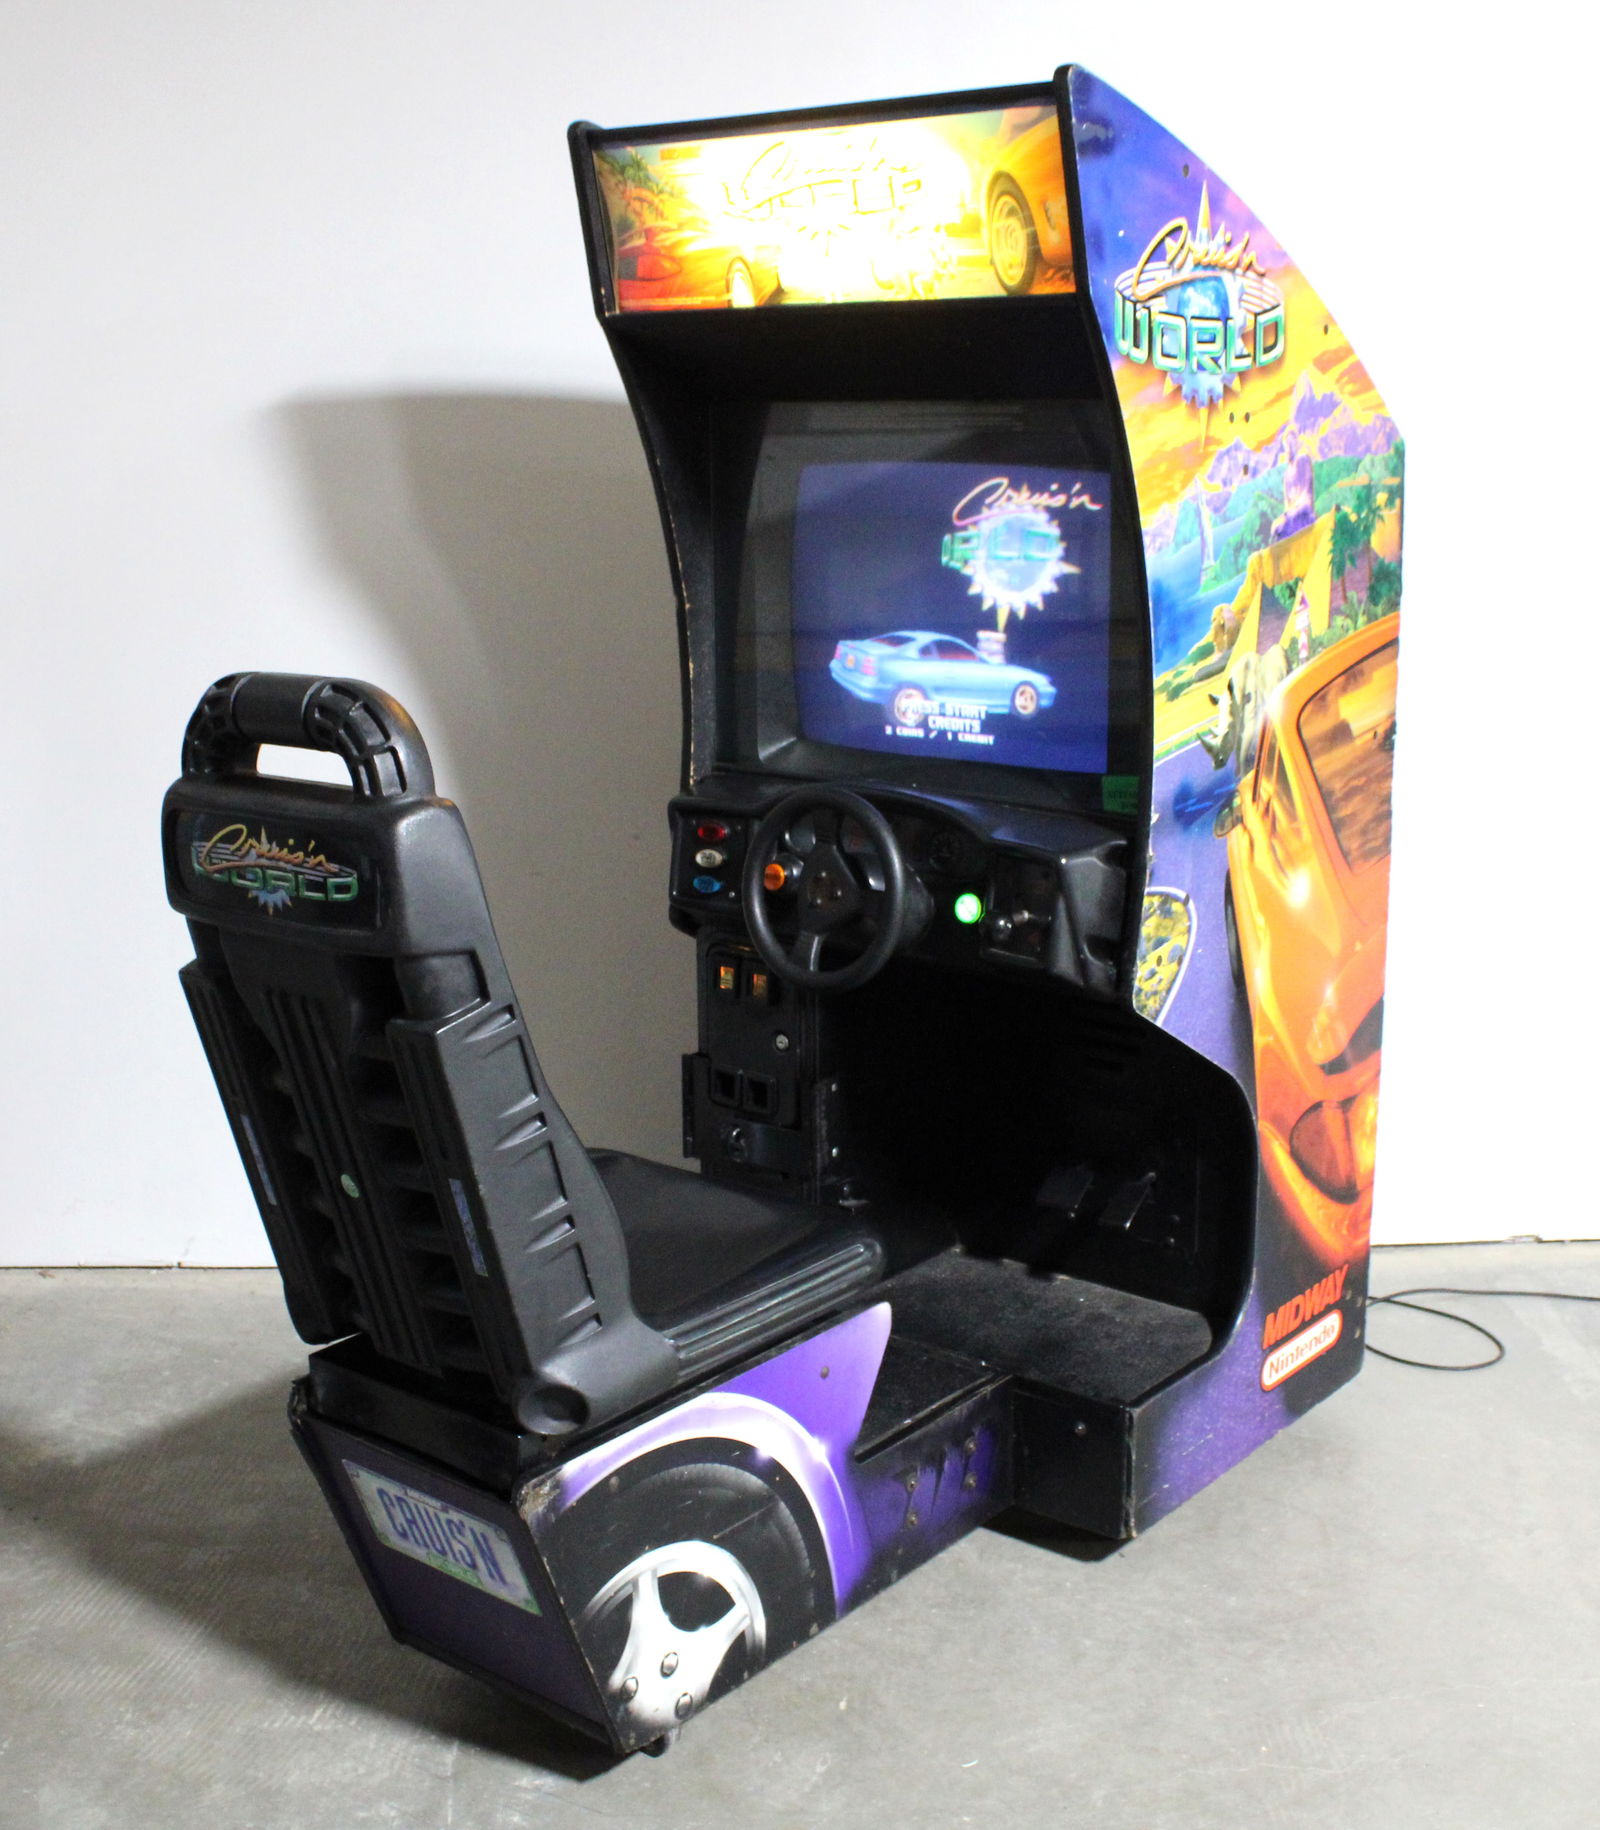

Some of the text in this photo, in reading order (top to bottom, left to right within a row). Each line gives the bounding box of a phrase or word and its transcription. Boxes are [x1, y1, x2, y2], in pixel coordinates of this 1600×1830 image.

[1114, 287, 1286, 374] WORLD
[927, 714, 982, 734] CREDITS
[957, 732, 995, 745] CREDIT
[1262, 1263, 1350, 1351] MIDWAY
[1267, 1322, 1336, 1380] Nintendo
